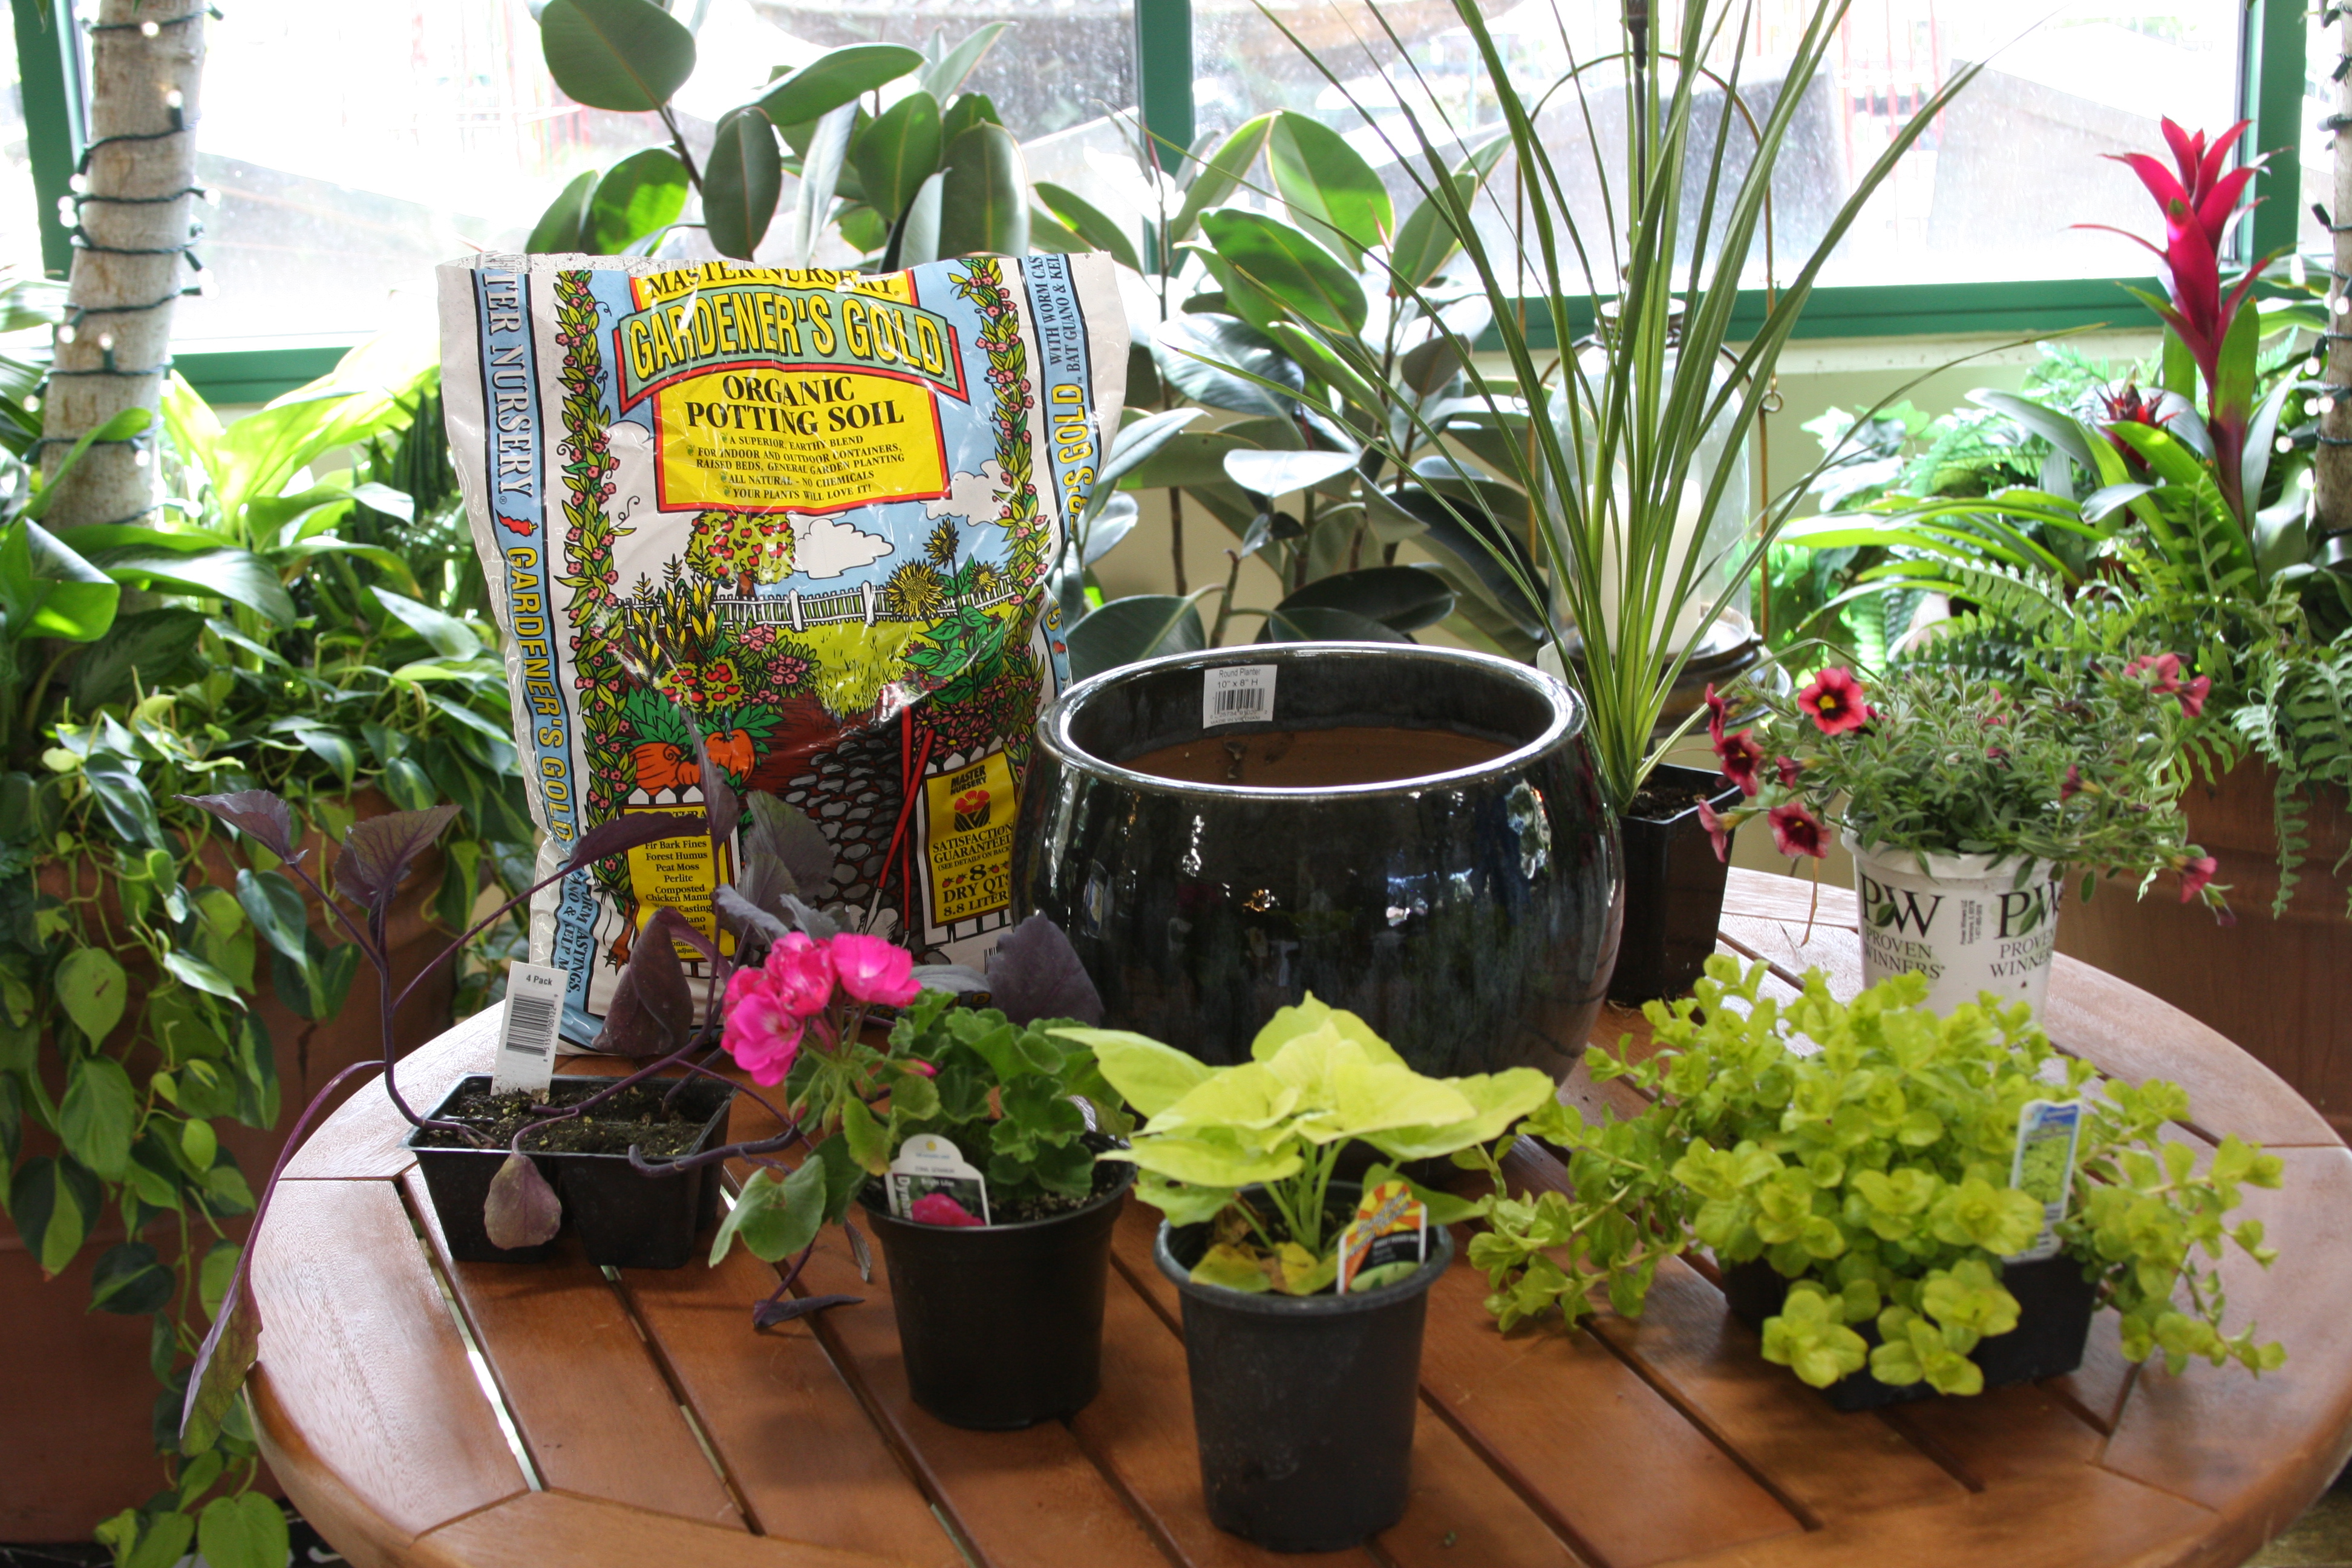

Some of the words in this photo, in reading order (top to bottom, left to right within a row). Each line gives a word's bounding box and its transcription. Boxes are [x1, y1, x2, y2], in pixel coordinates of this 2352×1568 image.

[1028, 255, 1046, 279] CAS
[1046, 253, 1063, 280] KEL
[1053, 283, 1066, 293] &
[1035, 283, 1057, 324] WORM
[1056, 297, 1077, 341] GUANO
[629, 291, 838, 382] GARDENER'S
[843, 297, 947, 378] GOLD
[1045, 327, 1062, 366] WITH
[1065, 344, 1080, 373] BAT
[722, 374, 855, 406] ORGANIC
[490, 344, 534, 497] NURSERY
[685, 400, 818, 435] POTTING
[828, 399, 905, 433] SOIL
[1051, 384, 1094, 465] GOLD
[697, 447, 716, 457] FOR
[720, 449, 760, 458] INDOOR
[763, 451, 780, 460] AND
[783, 454, 830, 463] OUTDOOR
[833, 443, 902, 460] CONTAINERS,
[739, 436, 787, 450] SUPERIOR,
[789, 439, 826, 451] EARTHY
[830, 435, 863, 447] BLEND
[696, 459, 732, 469] RAISED
[736, 461, 763, 471] BEDS,
[768, 463, 808, 474] GENERAL
[810, 461, 850, 475] GARDEN
[854, 454, 905, 468] PLANTING
[729, 474, 746, 483] ALL
[748, 475, 792, 485] NATURAL
[802, 477, 813, 487] NO
[816, 470, 874, 488] CHEMICALS
[733, 489, 760, 498] YOUR
[764, 489, 800, 499] PLANTS
[803, 490, 825, 501] WILL
[828, 486, 854, 499] LOVE
[857, 484, 872, 494] IT!
[1219, 669, 1238, 678] Round
[1240, 667, 1261, 676] Planter
[506, 547, 565, 748] GARDENER'S
[540, 757, 575, 841] GOLD
[950, 776, 986, 795] NURSERY
[952, 765, 986, 788] MASTER
[645, 841, 658, 850] Fir
[660, 840, 680, 849] Bark
[683, 839, 707, 848] Fines
[933, 823, 1013, 853] SATISFACTION
[645, 852, 674, 861] Forest
[675, 851, 708, 860] Humus
[954, 855, 981, 866] DETAILS
[656, 863, 675, 872] Peat
[677, 863, 699, 871] Moss
[970, 864, 987, 881] 8
[664, 874, 693, 883] Perlite
[655, 884, 705, 895] Composted
[943, 883, 979, 904] DRY
[575, 892, 593, 925] ORM
[678, 904, 712, 913] Casting
[944, 903, 965, 916] 8.8
[969, 890, 1008, 910] LITER
[1866, 926, 1932, 959] PROVEN
[526, 974, 531, 982] 4
[534, 975, 553, 986] Pack
[547, 1007, 557, 1027] 00122
[544, 1031, 552, 1050] 51510
